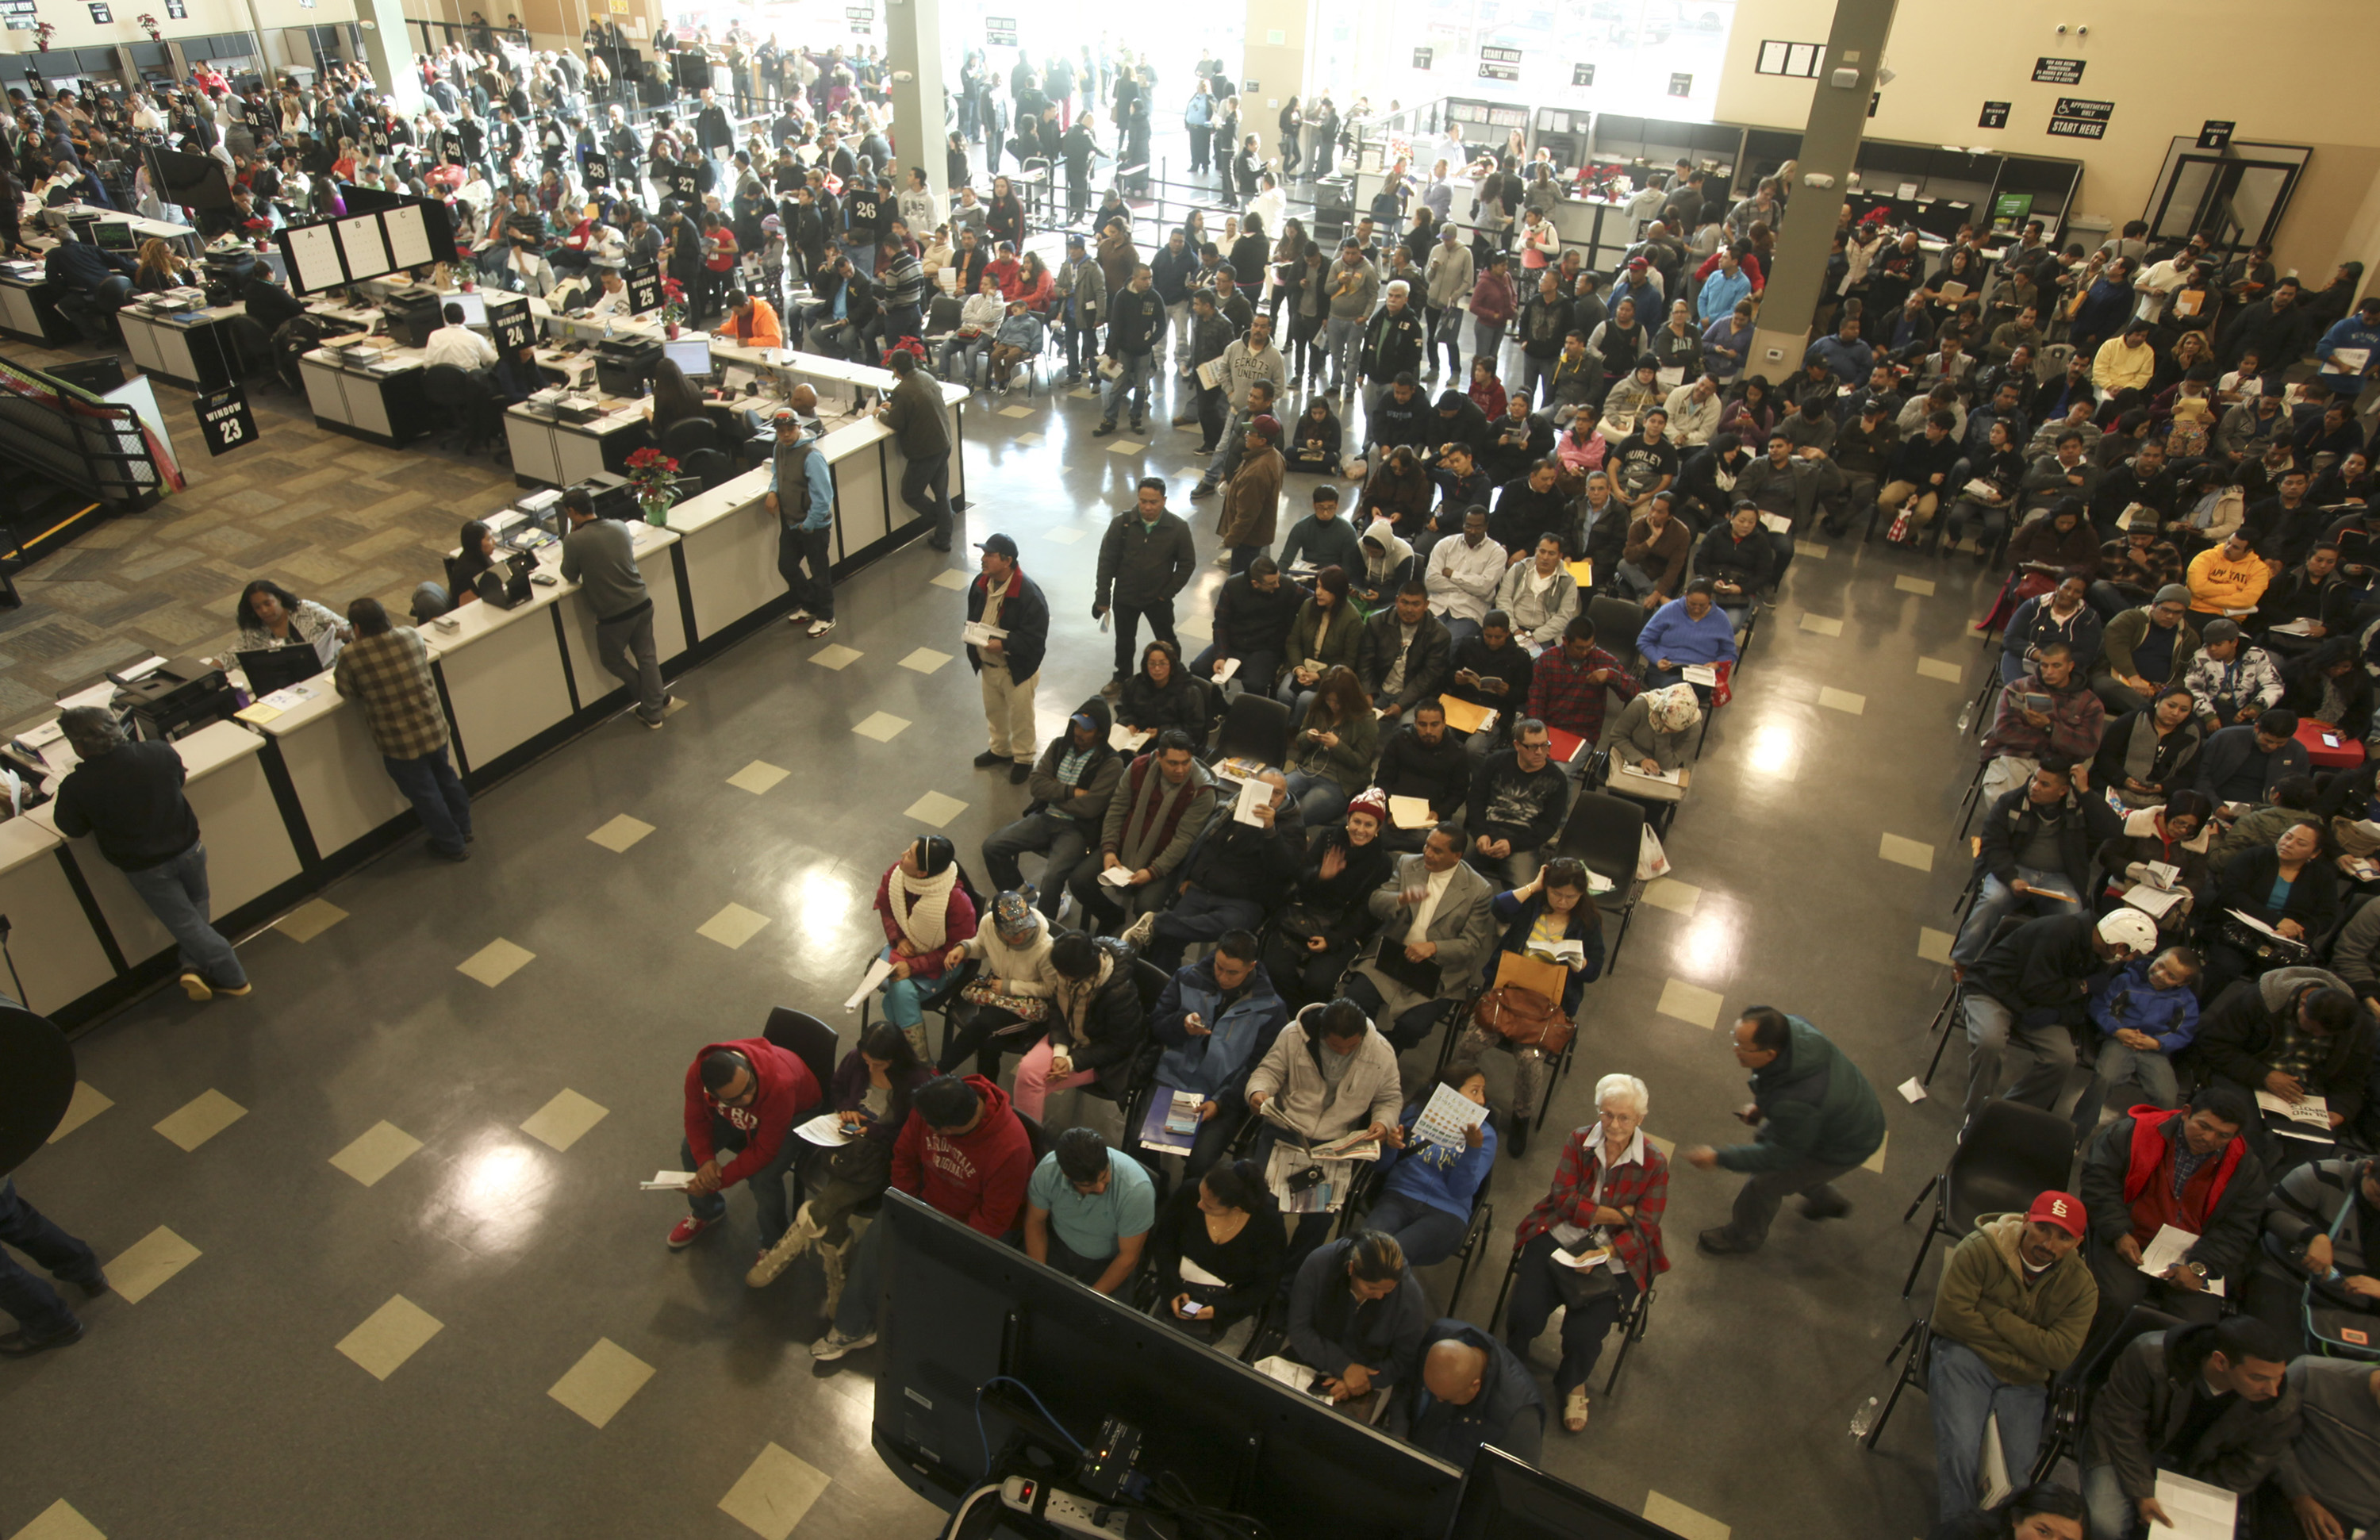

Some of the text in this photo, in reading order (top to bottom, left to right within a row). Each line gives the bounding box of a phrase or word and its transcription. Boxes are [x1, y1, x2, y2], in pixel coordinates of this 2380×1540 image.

[1483, 49, 1520, 62] START HERE
[1420, 59, 1425, 67] 1
[29, 79, 44, 92] 34
[1580, 75, 1586, 84] 2
[1676, 85, 1682, 94] 3
[183, 104, 197, 118] 32
[2070, 102, 2111, 111] APPOINTMENTS
[247, 112, 259, 126] 31
[1990, 114, 1998, 125] 5
[2052, 121, 2102, 136] START HERE
[374, 132, 389, 147] 30
[2209, 134, 2218, 146] 6
[446, 141, 461, 157] 29
[589, 162, 605, 179] 28
[678, 176, 696, 194] 27
[400, 210, 406, 219] C
[856, 201, 877, 219] 26
[631, 275, 656, 290] WINDOW
[639, 286, 654, 307] 25
[497, 312, 526, 328] WINDOW
[507, 325, 524, 348] 24
[1234, 357, 1257, 368] ECKO
[205, 401, 242, 422] WINDOW
[220, 417, 243, 444] 23
